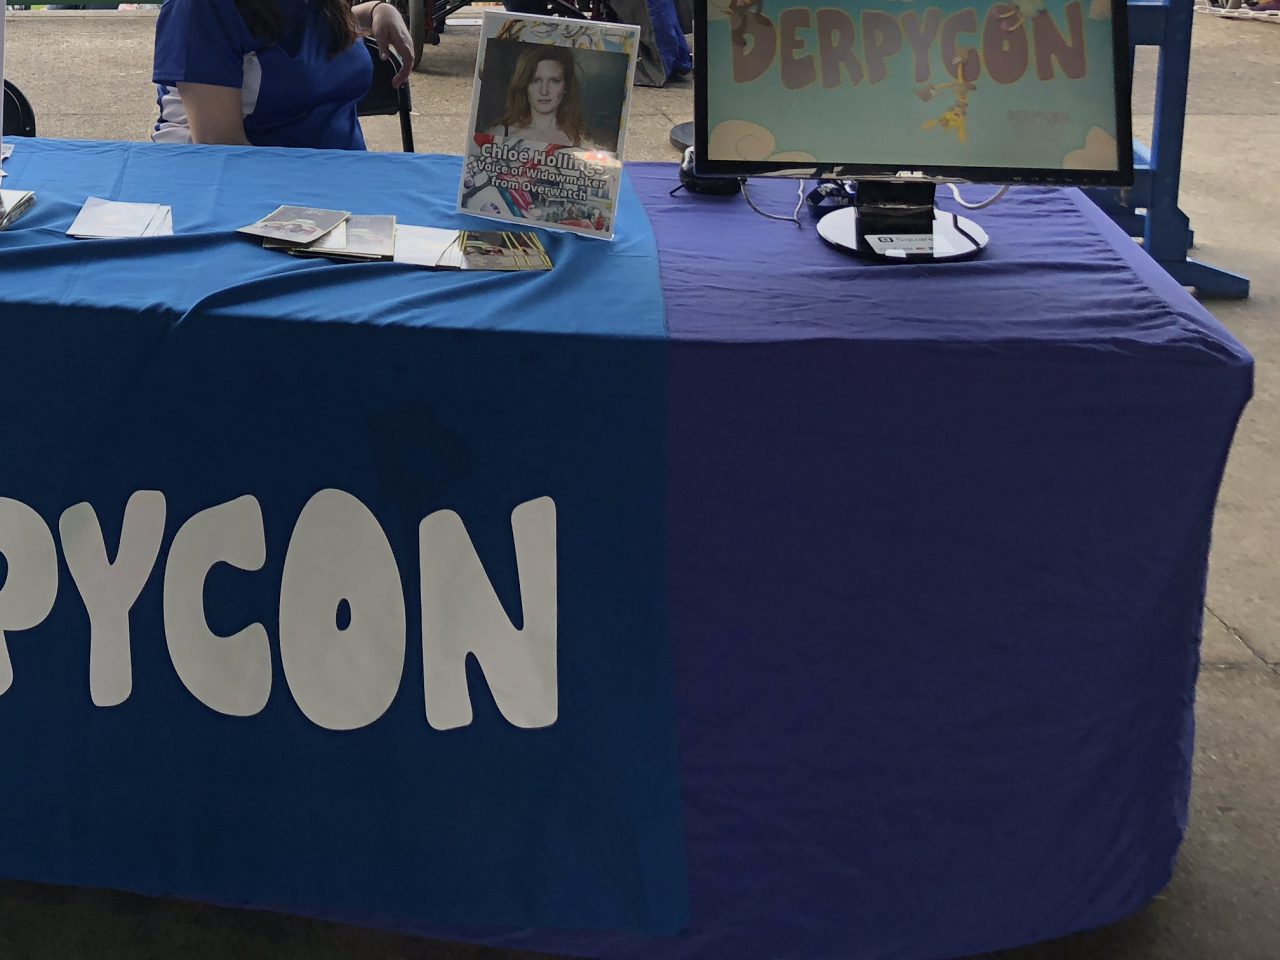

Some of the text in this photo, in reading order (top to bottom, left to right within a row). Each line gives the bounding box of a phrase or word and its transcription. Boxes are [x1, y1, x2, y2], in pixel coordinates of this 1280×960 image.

[728, 0, 1089, 91] DERPYCON
[477, 160, 606, 190] Voice of Widowmaker
[481, 143, 606, 177] Chloé Hollings
[490, 175, 588, 201] from Overwatch
